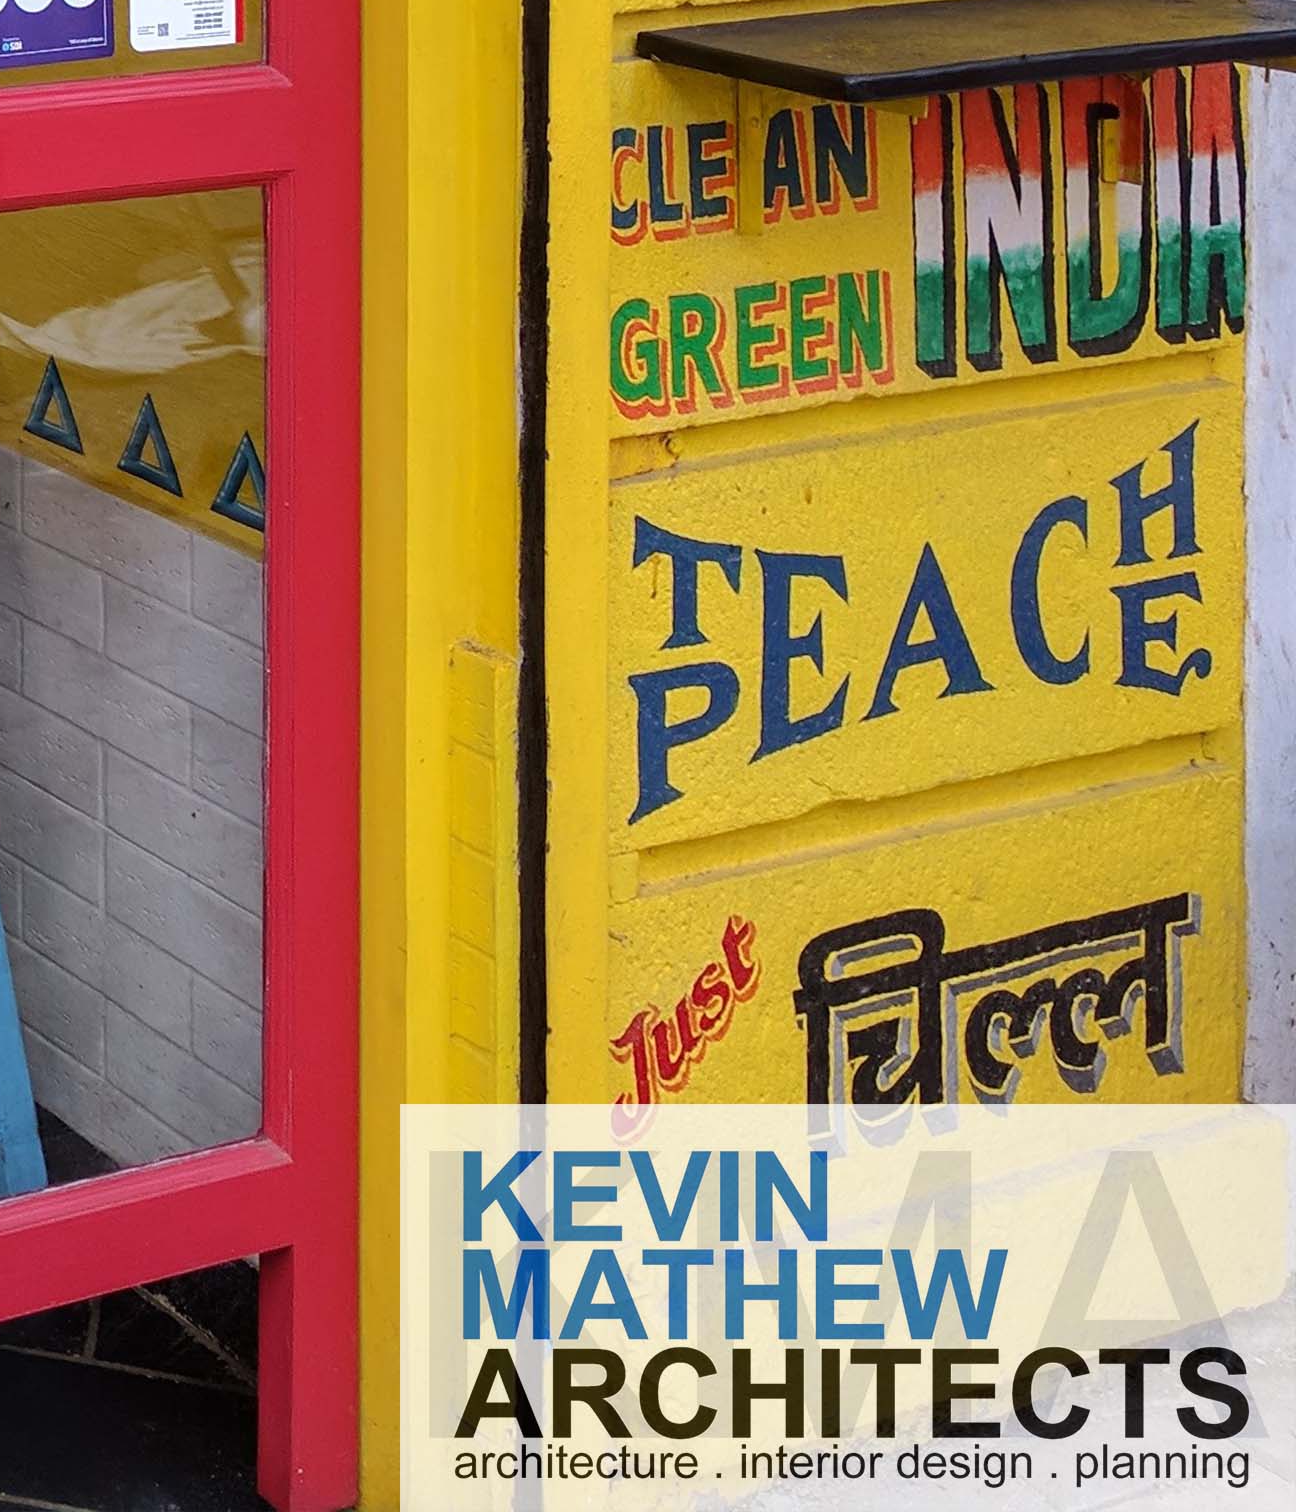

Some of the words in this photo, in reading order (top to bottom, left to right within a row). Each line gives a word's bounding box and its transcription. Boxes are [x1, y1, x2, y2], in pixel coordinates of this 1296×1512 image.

[609, 101, 879, 246] CLEAN
[909, 62, 1247, 380] INDIA
[609, 268, 893, 421] GREEN
[608, 913, 760, 1146] Just
